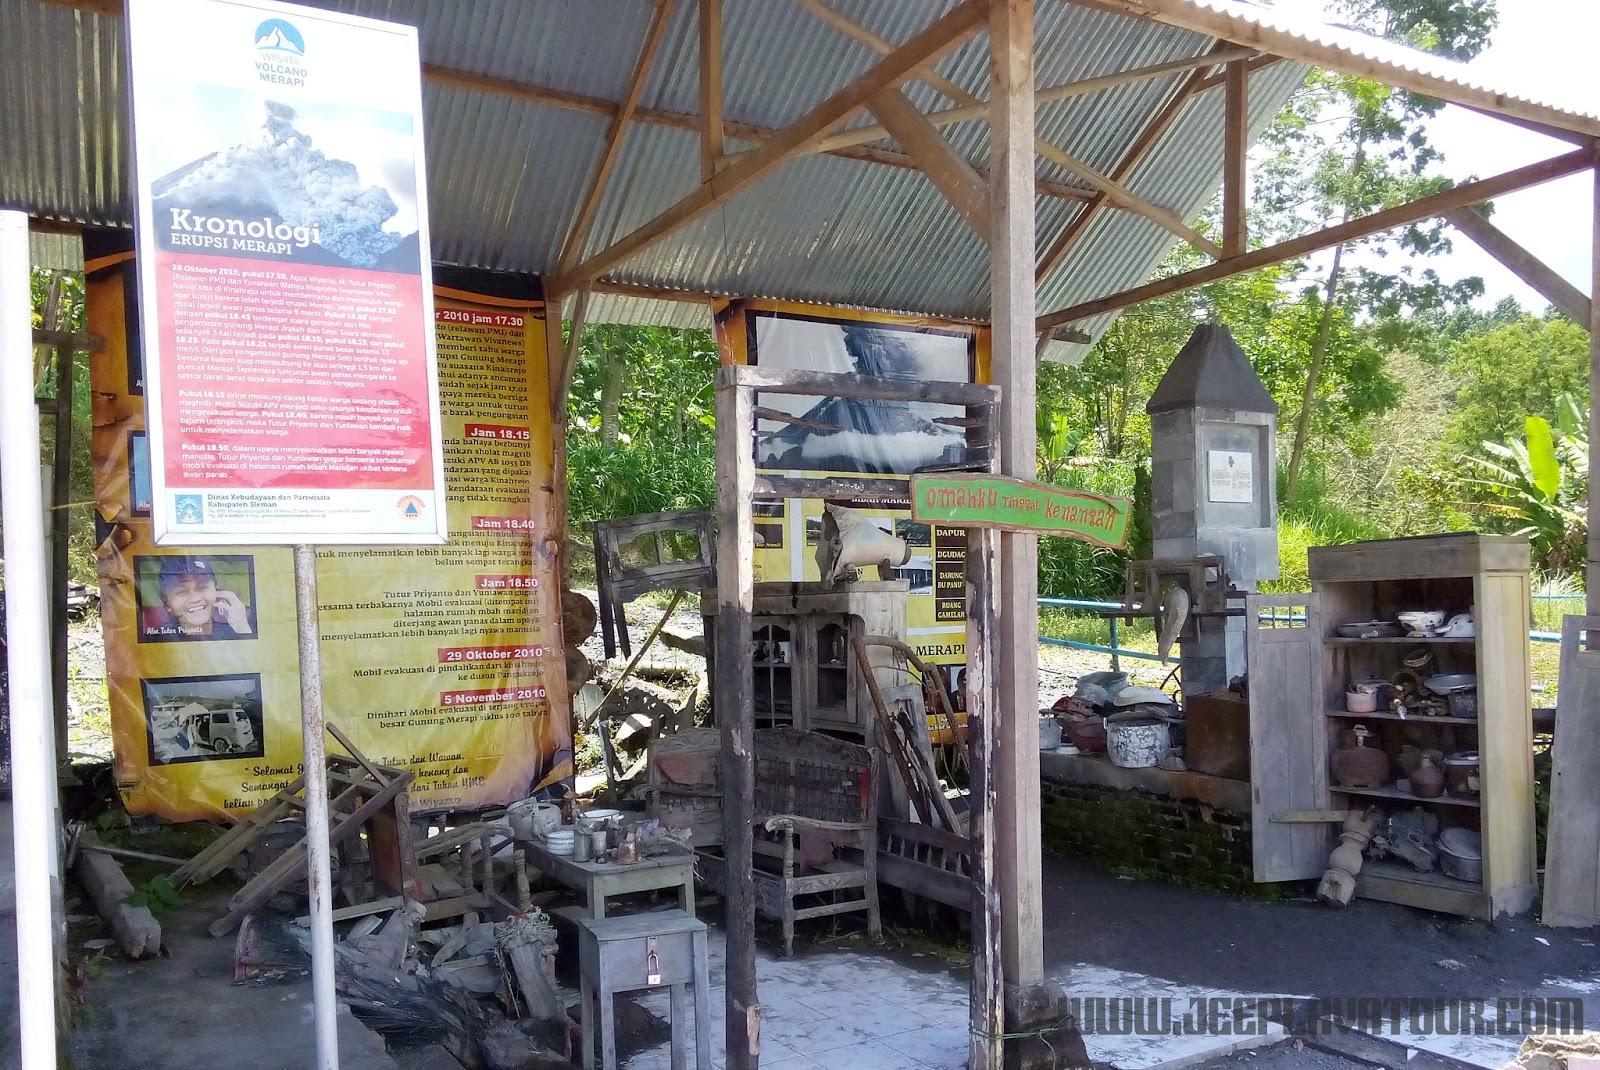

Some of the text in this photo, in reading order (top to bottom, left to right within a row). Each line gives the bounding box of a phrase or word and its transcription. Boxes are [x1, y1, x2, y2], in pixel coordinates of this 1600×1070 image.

[255, 61, 308, 78] VOLCANO
[260, 72, 304, 87] MERAPI
[170, 207, 320, 248] Kronologi
[170, 232, 292, 255] ERUPSI MERAPI
[184, 264, 217, 274] Oktober
[242, 269, 264, 280] pukul
[444, 311, 469, 321] 2010
[472, 314, 492, 324] jam
[495, 316, 523, 326] 17.30
[448, 324, 485, 334] (relawan
[487, 329, 507, 337] PMI)
[509, 330, 524, 338] dan
[484, 337, 524, 347] Vivanews)
[437, 343, 476, 352] memberi
[479, 345, 498, 353] tahu
[460, 354, 494, 363] Gunung
[496, 356, 526, 365] Merapi
[486, 365, 526, 375] Kinahrejo
[458, 371, 488, 380] adanya
[490, 375, 527, 383] ancaman
[467, 382, 506, 391] sejak jam
[465, 391, 528, 402] mereka bertiga
[477, 400, 502, 409] untuk
[477, 411, 529, 420] pengungsian
[471, 427, 530, 440] Jam 18.15
[181, 443, 205, 451] Pukul
[232, 444, 255, 452] dalam
[257, 446, 279, 454] upaya
[280, 445, 336, 455] menyelamatkan
[463, 439, 530, 449] bahaya berbunyi
[239, 453, 270, 462] Priyanto
[475, 448, 500, 456] sholat
[468, 457, 486, 465] APV
[481, 468, 532, 476] yang dipakai
[463, 476, 489, 484] warga
[490, 476, 530, 487] Kinahrejo
[448, 484, 494, 492] kendaraan
[231, 494, 276, 502] Kebudayaan
[467, 494, 489, 502] tidak
[477, 519, 534, 528] Jam 18.40
[936, 529, 966, 537] DAPUR
[462, 540, 495, 548] menuju
[338, 549, 414, 558] menyelamatkan
[416, 548, 439, 556] lebih
[442, 549, 473, 557] banyak
[435, 558, 463, 566] belum
[481, 578, 538, 587] Jam 18.50
[413, 589, 452, 598] Priyanto
[455, 589, 471, 597] dan
[356, 601, 413, 610] terbakarnya
[416, 599, 442, 607] Mobil
[403, 609, 444, 618] halaman
[446, 608, 476, 616] rumah
[393, 619, 436, 628] diterjang
[321, 631, 399, 641] menyelamatkan
[427, 628, 459, 637] banyak
[461, 628, 477, 636] lagi
[447, 648, 543, 661] 29 Oktober 2010
[916, 644, 965, 656] MERAPI
[353, 662, 502, 677] Mobil evakuasi di pindahkan dari
[470, 672, 495, 680] dusun
[444, 689, 546, 704] 5 November 2010
[367, 710, 407, 719] Dinihari
[409, 707, 436, 716] Mobil
[438, 705, 477, 714] evakuasi
[489, 702, 518, 712] terjang
[408, 717, 444, 726] Gunung
[446, 715, 478, 723] Merapi
[410, 752, 464, 764] dan Wawan.
[253, 764, 293, 776] Selamat
[419, 765, 469, 778] kenang dan
[241, 780, 289, 792] Semangat
[411, 782, 430, 792] dari
[432, 780, 459, 791] Tuhan
